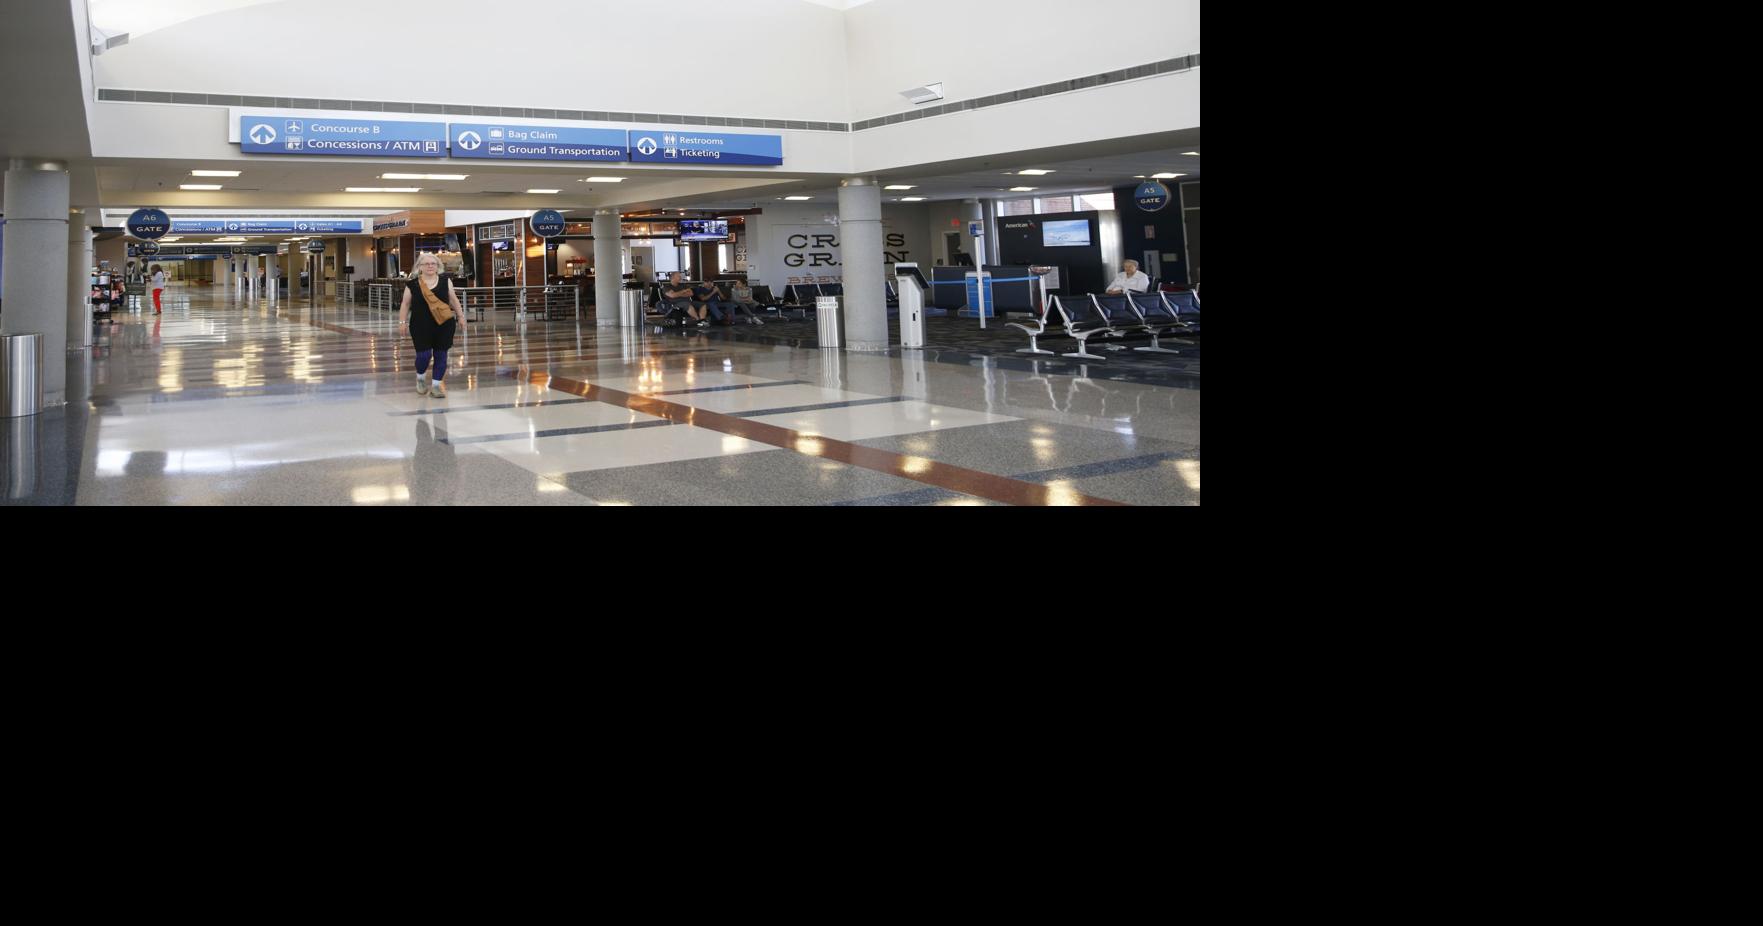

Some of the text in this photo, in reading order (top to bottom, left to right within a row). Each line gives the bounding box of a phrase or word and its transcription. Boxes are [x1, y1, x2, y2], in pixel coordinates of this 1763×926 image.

[311, 123, 380, 135] Concourse B
[508, 130, 558, 141] Bag Claim
[679, 136, 724, 146] Restrooms
[307, 138, 420, 151] Concessions / ATM
[507, 145, 620, 158] Ground Transportation
[681, 148, 720, 159] Ticketing
[787, 233, 905, 249] CRS
[783, 251, 910, 267] GRN
